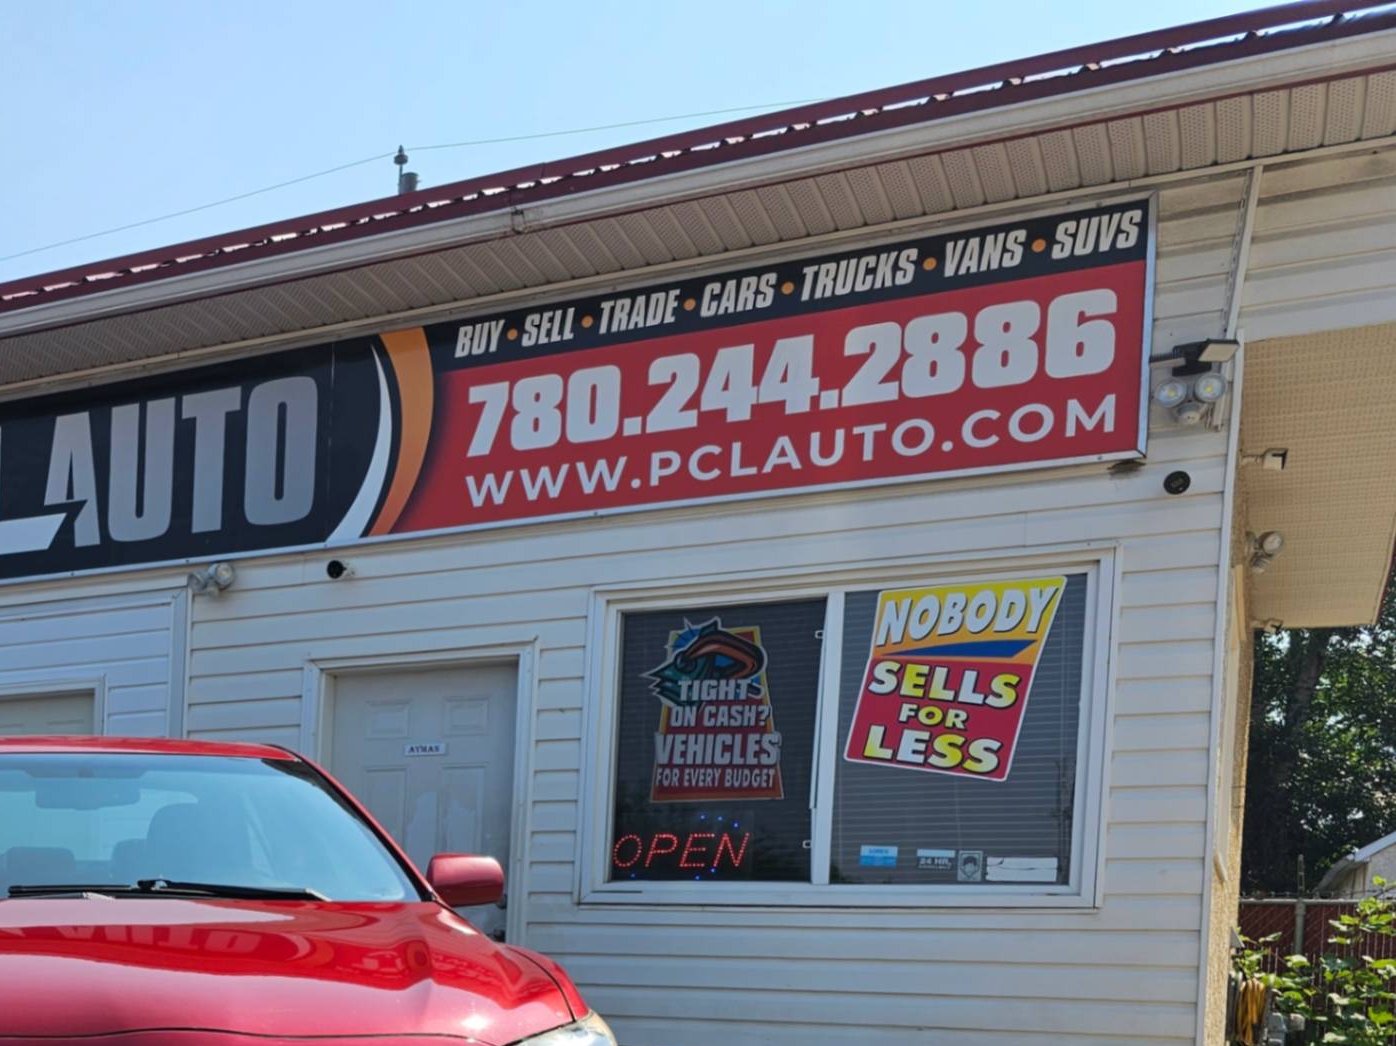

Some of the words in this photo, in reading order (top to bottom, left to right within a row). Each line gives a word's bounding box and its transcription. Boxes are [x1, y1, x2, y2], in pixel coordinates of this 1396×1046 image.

[454, 319, 505, 358] BUY
[521, 307, 575, 347] SELL
[599, 289, 680, 330] TRADE
[700, 273, 778, 318] CARS
[801, 249, 918, 301] TRUCKS
[944, 228, 1027, 277] VANS
[1051, 209, 1142, 261] SUVS
[465, 288, 1118, 458] 780.244.2886
[44, 375, 319, 547] AUTO
[465, 394, 1118, 508] WWW.PCLAUTO.COM
[876, 585, 1060, 647] NOBODY
[677, 678, 752, 700] TIGHT
[868, 660, 1022, 709] SELLS
[670, 705, 697, 727] ON
[703, 703, 771, 727] CASH?
[898, 703, 968, 730] FOR
[655, 732, 781, 765] VEHICLES
[862, 724, 1002, 774] LESS
[656, 768, 680, 787] FOR
[683, 768, 721, 787] EVERY
[724, 767, 776, 788] BUDGET
[613, 832, 750, 868] OPEN
